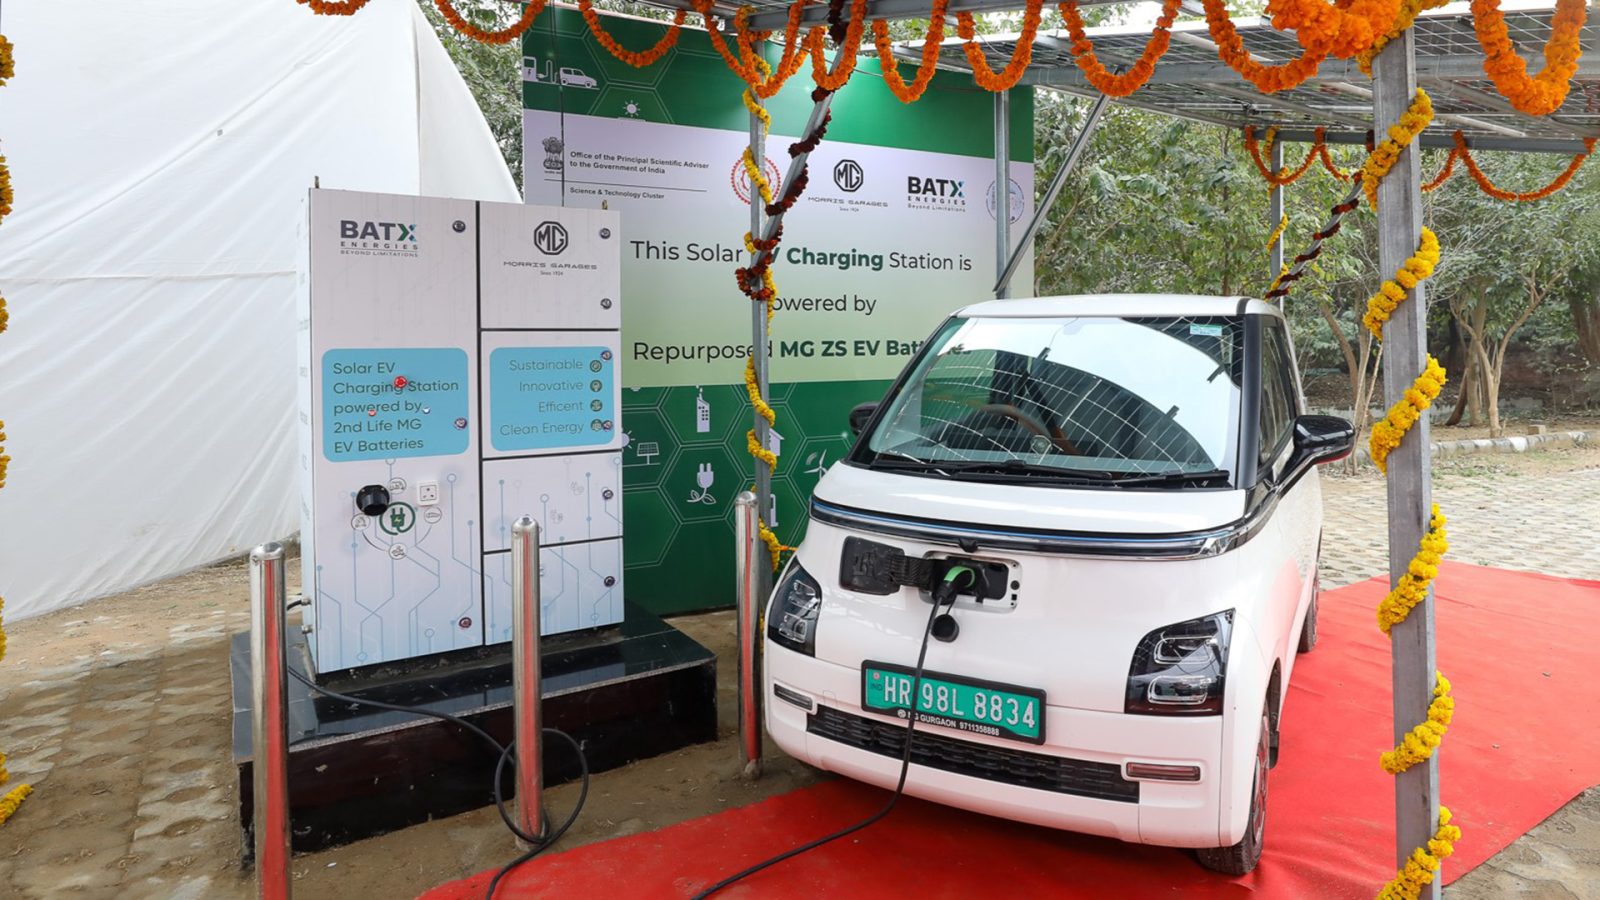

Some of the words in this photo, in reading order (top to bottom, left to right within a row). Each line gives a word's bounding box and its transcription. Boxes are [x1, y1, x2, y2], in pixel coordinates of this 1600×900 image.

[570, 151, 592, 159] Office
[616, 155, 648, 164] Principal
[650, 158, 682, 167] Scientific
[683, 161, 709, 169] Adviser
[593, 162, 638, 172] Government
[648, 167, 666, 175] India
[836, 162, 861, 190] MG
[570, 187, 596, 195] Science
[605, 189, 641, 199] Technology
[908, 176, 966, 198] BATX
[848, 200, 889, 208] GARAGES
[908, 195, 966, 206] ENERGIES
[340, 220, 417, 243] BATX
[537, 224, 565, 252] MG
[340, 241, 418, 250] ENERGIES
[372, 250, 418, 258] LIMITATIONS
[630, 240, 680, 260] This
[686, 243, 743, 262] Solar
[786, 247, 884, 271] Charging
[889, 252, 953, 270] Station
[959, 254, 972, 271] is
[772, 294, 847, 313] owered
[853, 294, 877, 316] by
[780, 340, 815, 358] MG
[821, 340, 848, 357] ZS
[854, 340, 880, 357] EV
[333, 362, 373, 375] Solar
[377, 362, 396, 374] EV
[509, 359, 583, 371] Sustainable
[333, 381, 404, 396] Charging
[408, 380, 459, 392] Station
[519, 381, 583, 392] Innovative
[334, 401, 400, 416] powered
[405, 400, 423, 413] by
[538, 401, 584, 413] Efficent
[334, 421, 362, 434] 2nd
[367, 419, 393, 432] Life
[397, 419, 422, 430] MG
[500, 424, 539, 436] Clean
[543, 422, 585, 434] Energy
[334, 441, 353, 453] EV
[358, 438, 424, 452] Batteries
[884, 676, 910, 706] HR
[922, 683, 964, 716] 98L
[974, 692, 1035, 729] 8834
[920, 714, 956, 728] GURGAON
